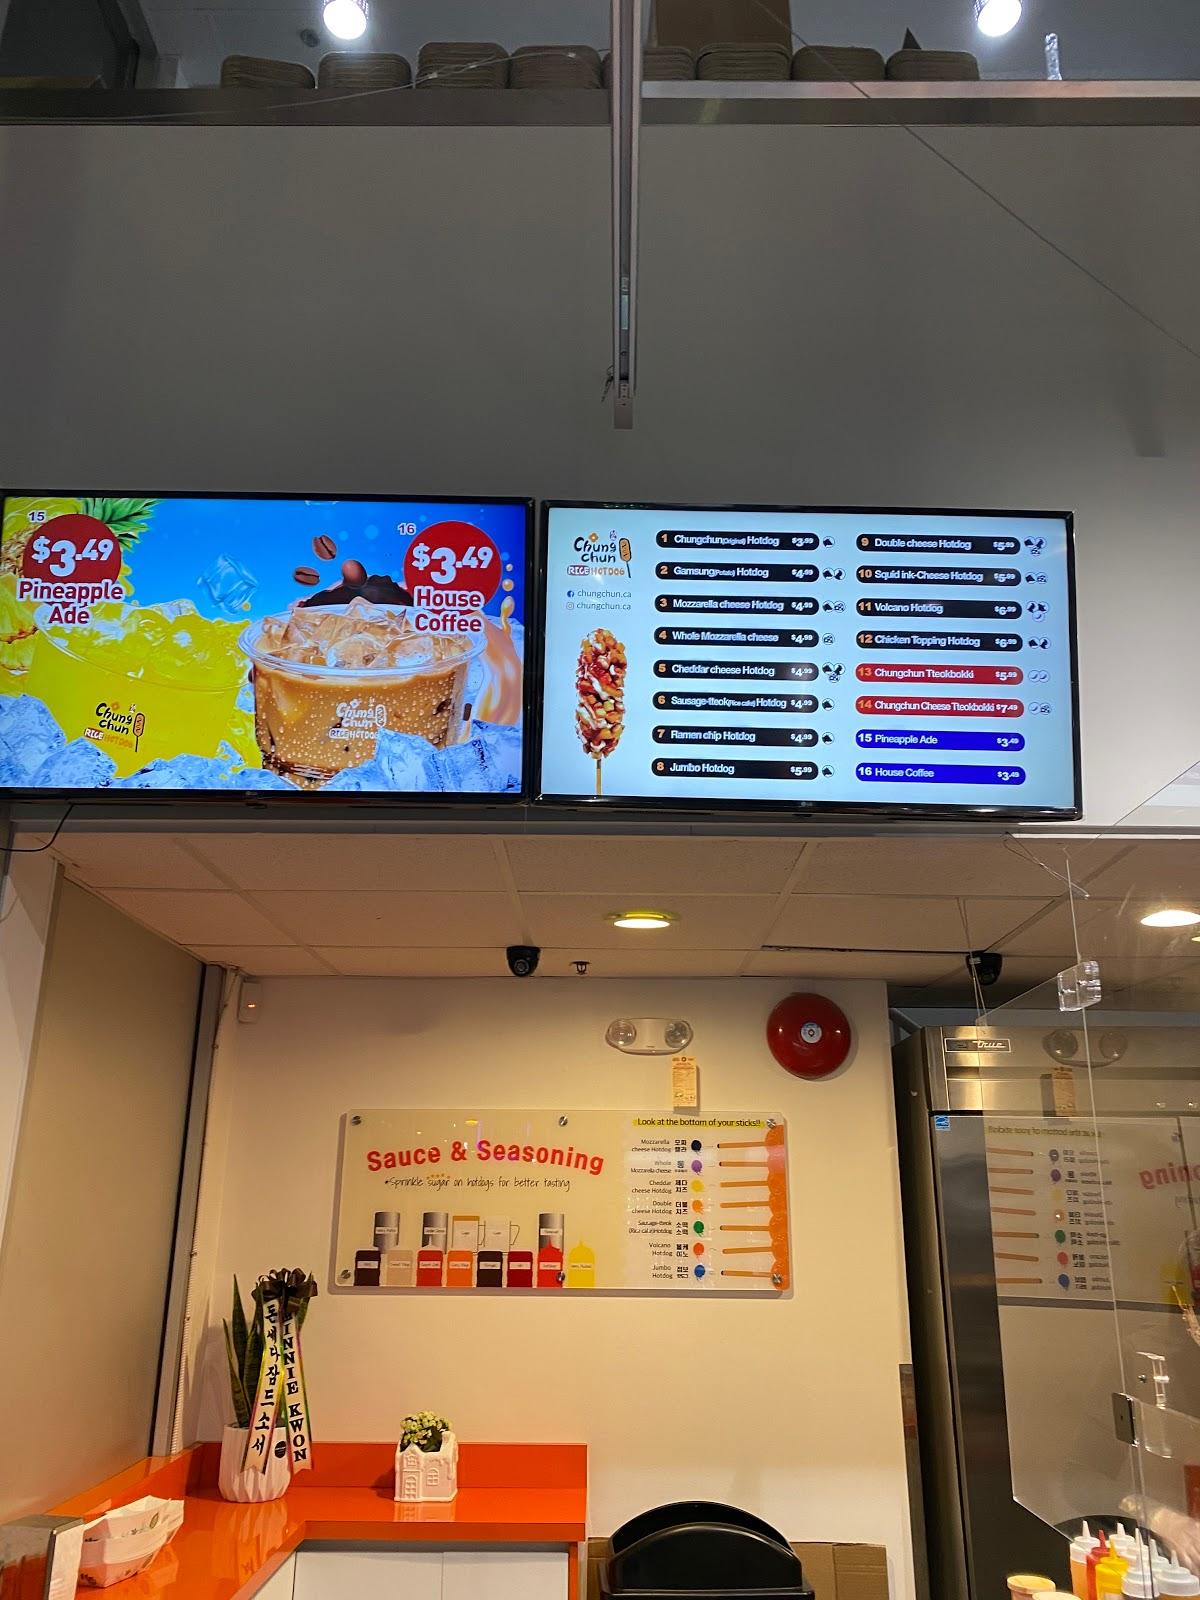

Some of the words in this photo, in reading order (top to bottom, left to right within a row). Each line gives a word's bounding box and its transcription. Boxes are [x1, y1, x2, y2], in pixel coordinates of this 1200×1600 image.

[29, 511, 45, 521] 15
[398, 523, 416, 535] 16
[574, 537, 617, 553] Chung
[661, 534, 667, 542] 1
[747, 536, 779, 546] Hotdog
[861, 537, 868, 546] 9
[875, 538, 905, 547] Double
[907, 539, 938, 548] cheese
[939, 540, 971, 550] Hotdog
[32, 536, 114, 576] $3.49
[412, 543, 493, 584] $3.49
[568, 566, 590, 575] RICE
[591, 567, 625, 575] HOTDOG
[660, 566, 668, 574] 2
[736, 568, 769, 578] Hotdog
[858, 569, 872, 578] 10
[875, 570, 900, 580] Squid
[901, 570, 949, 580] ink-Cheese
[950, 571, 983, 582] Hotdog
[19, 581, 123, 603] Pineapple
[416, 589, 481, 607] House
[577, 589, 632, 598] chungchun.ca
[576, 602, 632, 610] chungchun.ca
[660, 598, 667, 607] 3
[673, 599, 718, 608] Mozzarella
[719, 601, 750, 609] cheese
[751, 601, 784, 611] Hotdog
[858, 602, 871, 610] 11
[875, 602, 909, 612] Volcano
[911, 604, 943, 614] Hotdog
[49, 606, 90, 624] Ade
[415, 612, 482, 632] Coffee
[659, 631, 667, 639] 4
[672, 631, 700, 640] Whole
[701, 632, 746, 641] Mozzarella
[747, 633, 778, 642] cheese
[858, 634, 872, 643] 12
[875, 635, 910, 644] Chicken
[911, 636, 946, 647] Topping
[948, 637, 980, 647] Hotdog
[659, 664, 666, 672] 5
[672, 664, 709, 673] Cheddar
[710, 666, 741, 674] cheese
[742, 666, 775, 676] Hotdog
[858, 667, 871, 676] 13
[875, 668, 924, 679] Chungchun
[658, 696, 666, 704] 6
[756, 698, 786, 708] Hotdog
[858, 700, 871, 708] 14
[875, 701, 920, 711] Chungchun
[921, 702, 950, 711] Cheese
[996, 704, 1017, 713] $7.49
[96, 703, 132, 725] Chung
[85, 728, 104, 740] RICE
[657, 729, 665, 738] 7
[671, 730, 701, 739] Ramen
[703, 730, 721, 741] chip
[723, 732, 755, 742] Hotdog
[858, 733, 872, 742] 15
[875, 734, 918, 745] Pineapple
[920, 735, 938, 744] Ade
[997, 738, 1019, 747] $3.49
[657, 762, 664, 771] 8
[670, 763, 700, 772] Jumbo
[701, 764, 734, 774] Hotdog
[791, 766, 812, 776] $5.99
[858, 767, 872, 776] 16
[875, 768, 903, 777] House
[905, 769, 934, 777] Coffee
[998, 771, 1019, 781] $3.49
[367, 1147, 440, 1171] Sauce
[451, 1141, 467, 1161] &
[477, 1140, 604, 1176] Seasoning
[427, 1178, 450, 1191] sugar
[467, 1177, 494, 1191] hotdogs
[498, 1176, 509, 1187] for
[514, 1177, 539, 1187] better
[544, 1178, 570, 1192] tasting
[288, 1403, 307, 1462] KWON
